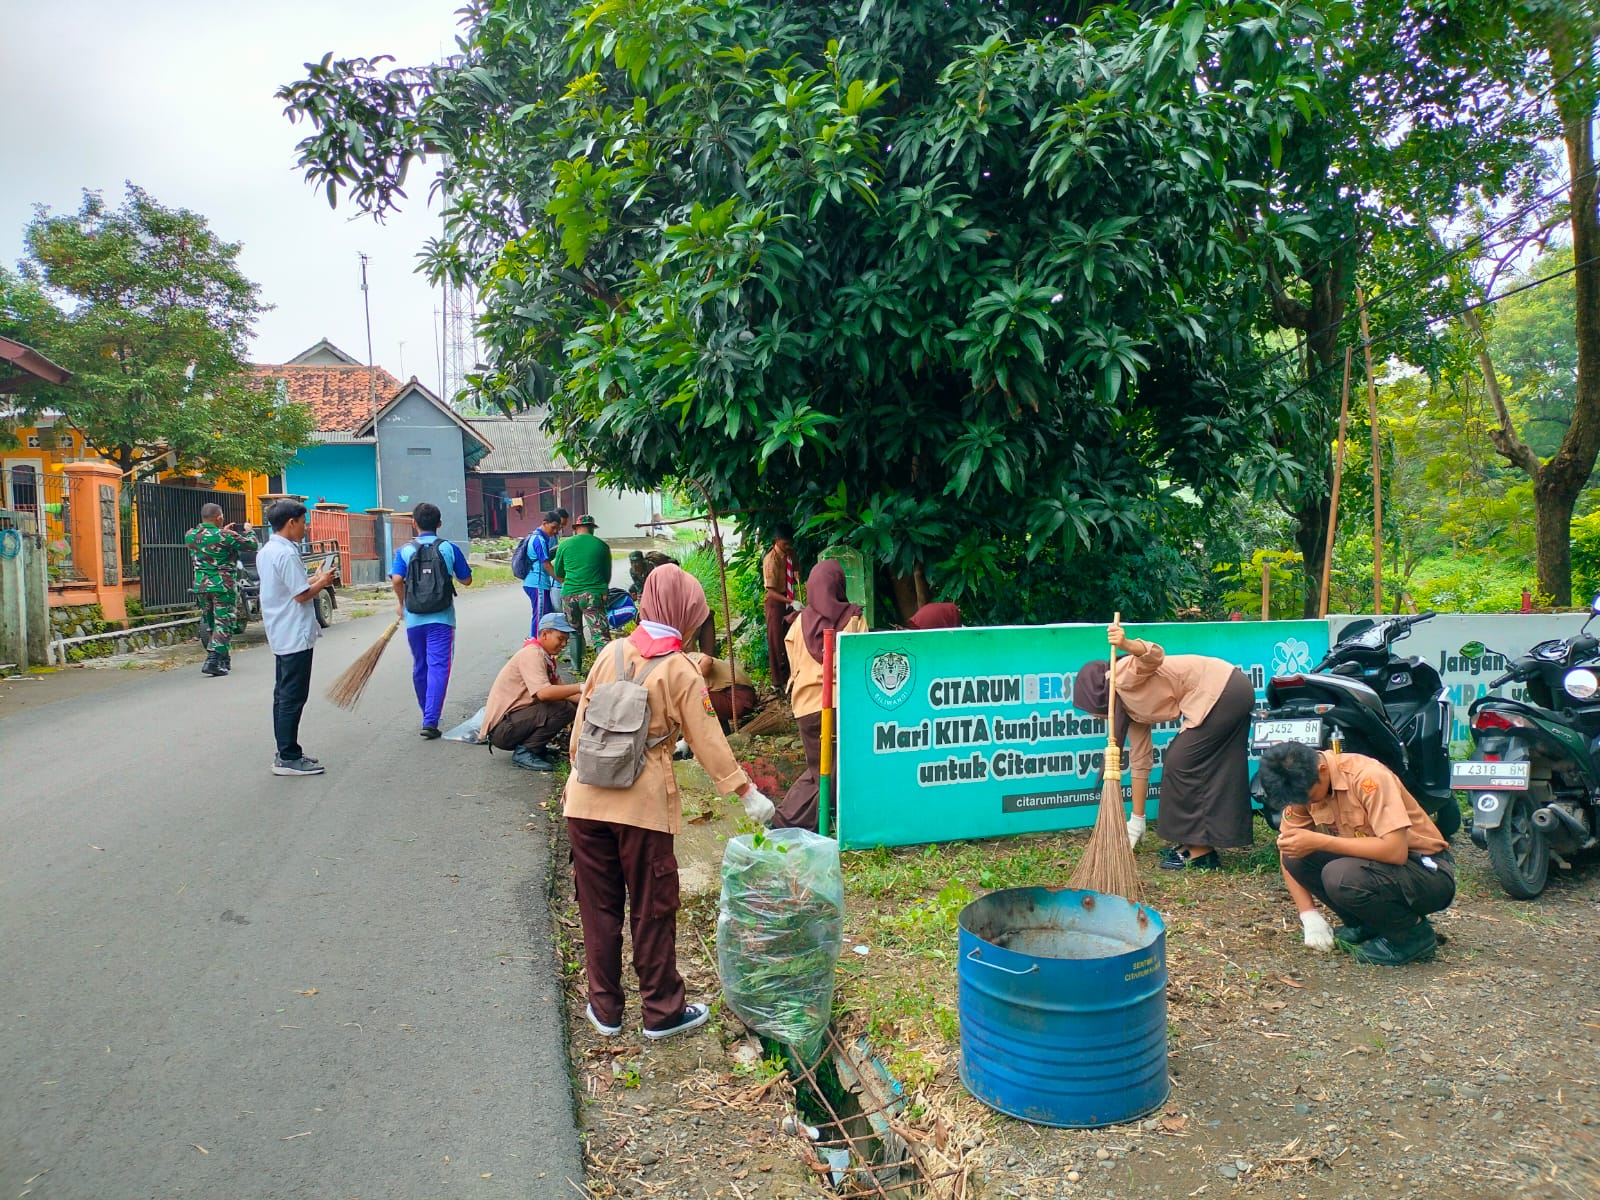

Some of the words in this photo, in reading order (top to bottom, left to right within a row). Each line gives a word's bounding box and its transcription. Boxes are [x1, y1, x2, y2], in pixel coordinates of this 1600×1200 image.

[929, 678, 1020, 707] CITARUM
[1024, 674, 1072, 700] BERS
[876, 722, 929, 751] Mari
[935, 718, 989, 746] KITA
[994, 713, 1106, 743] tunjukkan
[1257, 724, 1262, 735] T
[1268, 723, 1293, 734] 3452
[919, 755, 987, 784] untuk
[992, 752, 1074, 777] Citarun
[1078, 749, 1130, 776] yag
[1455, 765, 1462, 775] T
